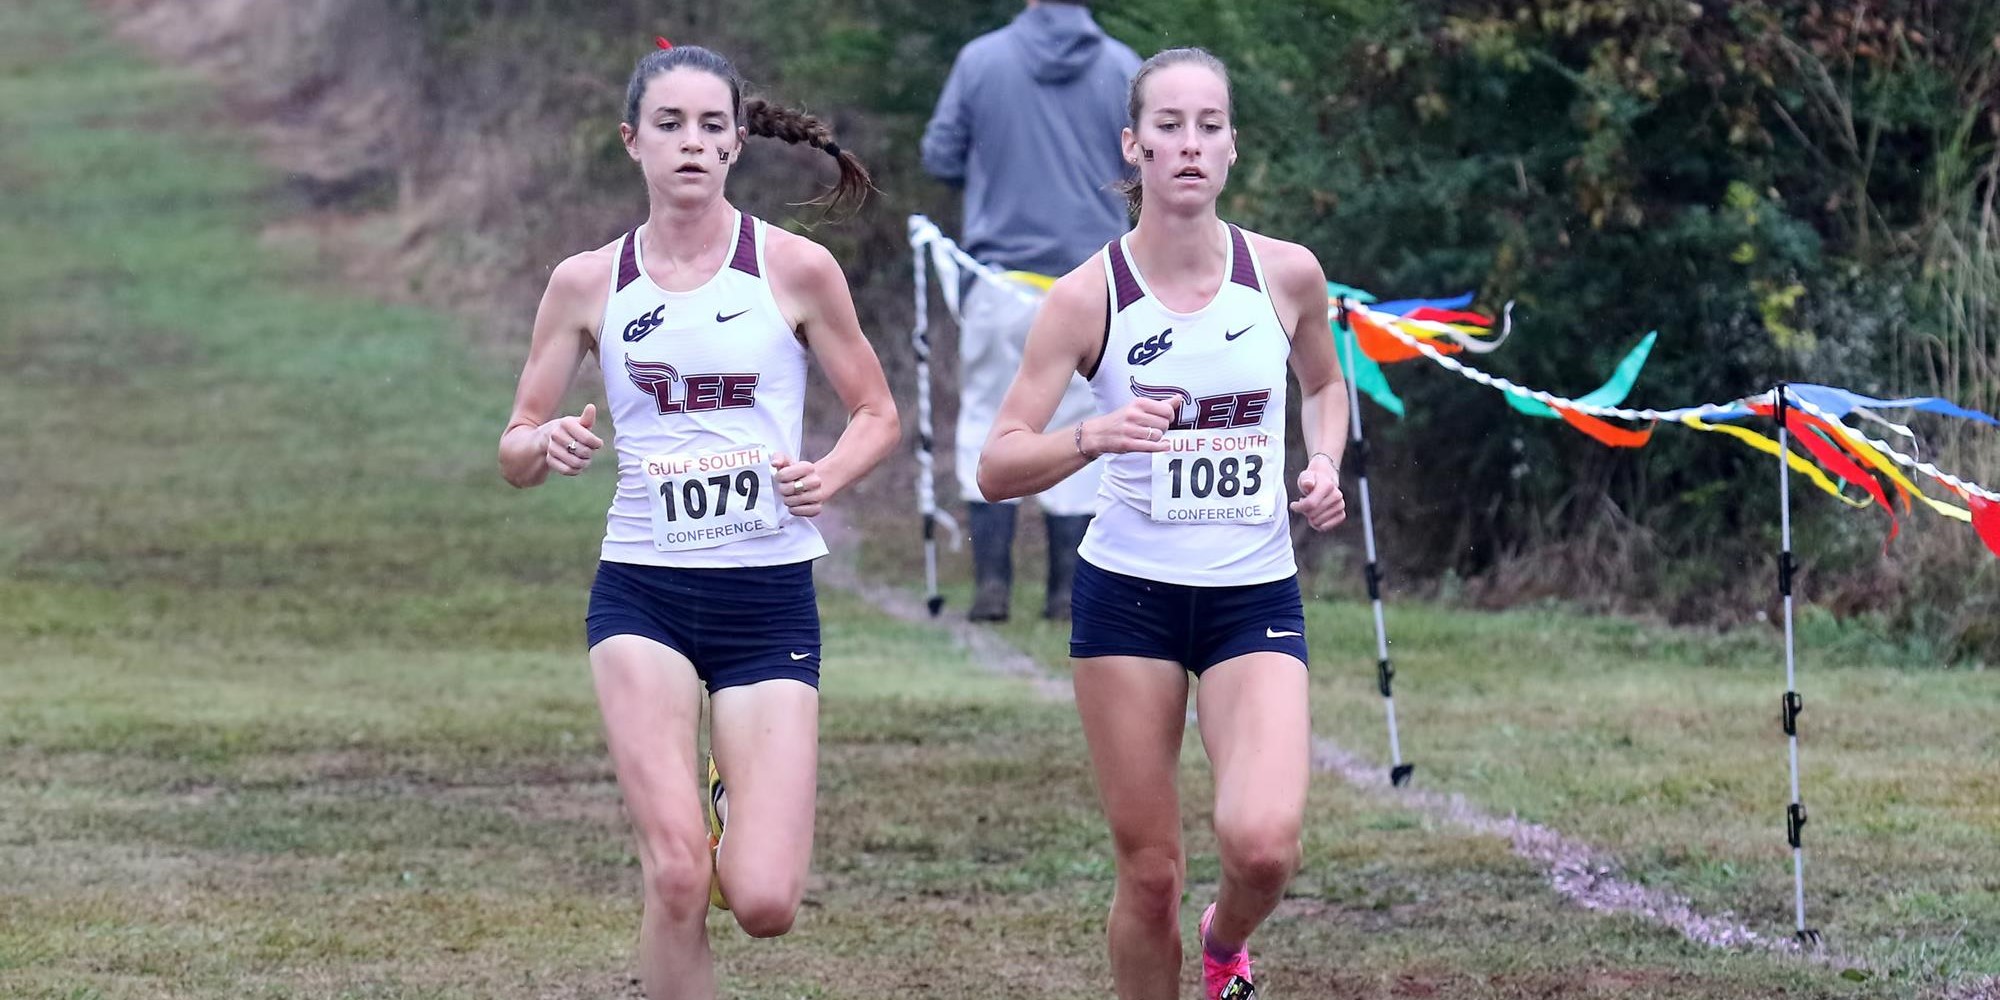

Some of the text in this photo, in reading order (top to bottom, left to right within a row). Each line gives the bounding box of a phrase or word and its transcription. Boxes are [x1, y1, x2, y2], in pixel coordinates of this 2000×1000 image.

[622, 304, 666, 342] GSC
[1127, 327, 1173, 366] GSC
[652, 372, 760, 416] LEE
[1161, 434, 1268, 452] ULF SOUTH
[647, 449, 761, 477] GULF SOUTH
[1168, 454, 1264, 499] 1083
[659, 469, 760, 522] 1079
[1167, 505, 1262, 521] CONFERENCE
[666, 519, 763, 545] CONFERENCE
